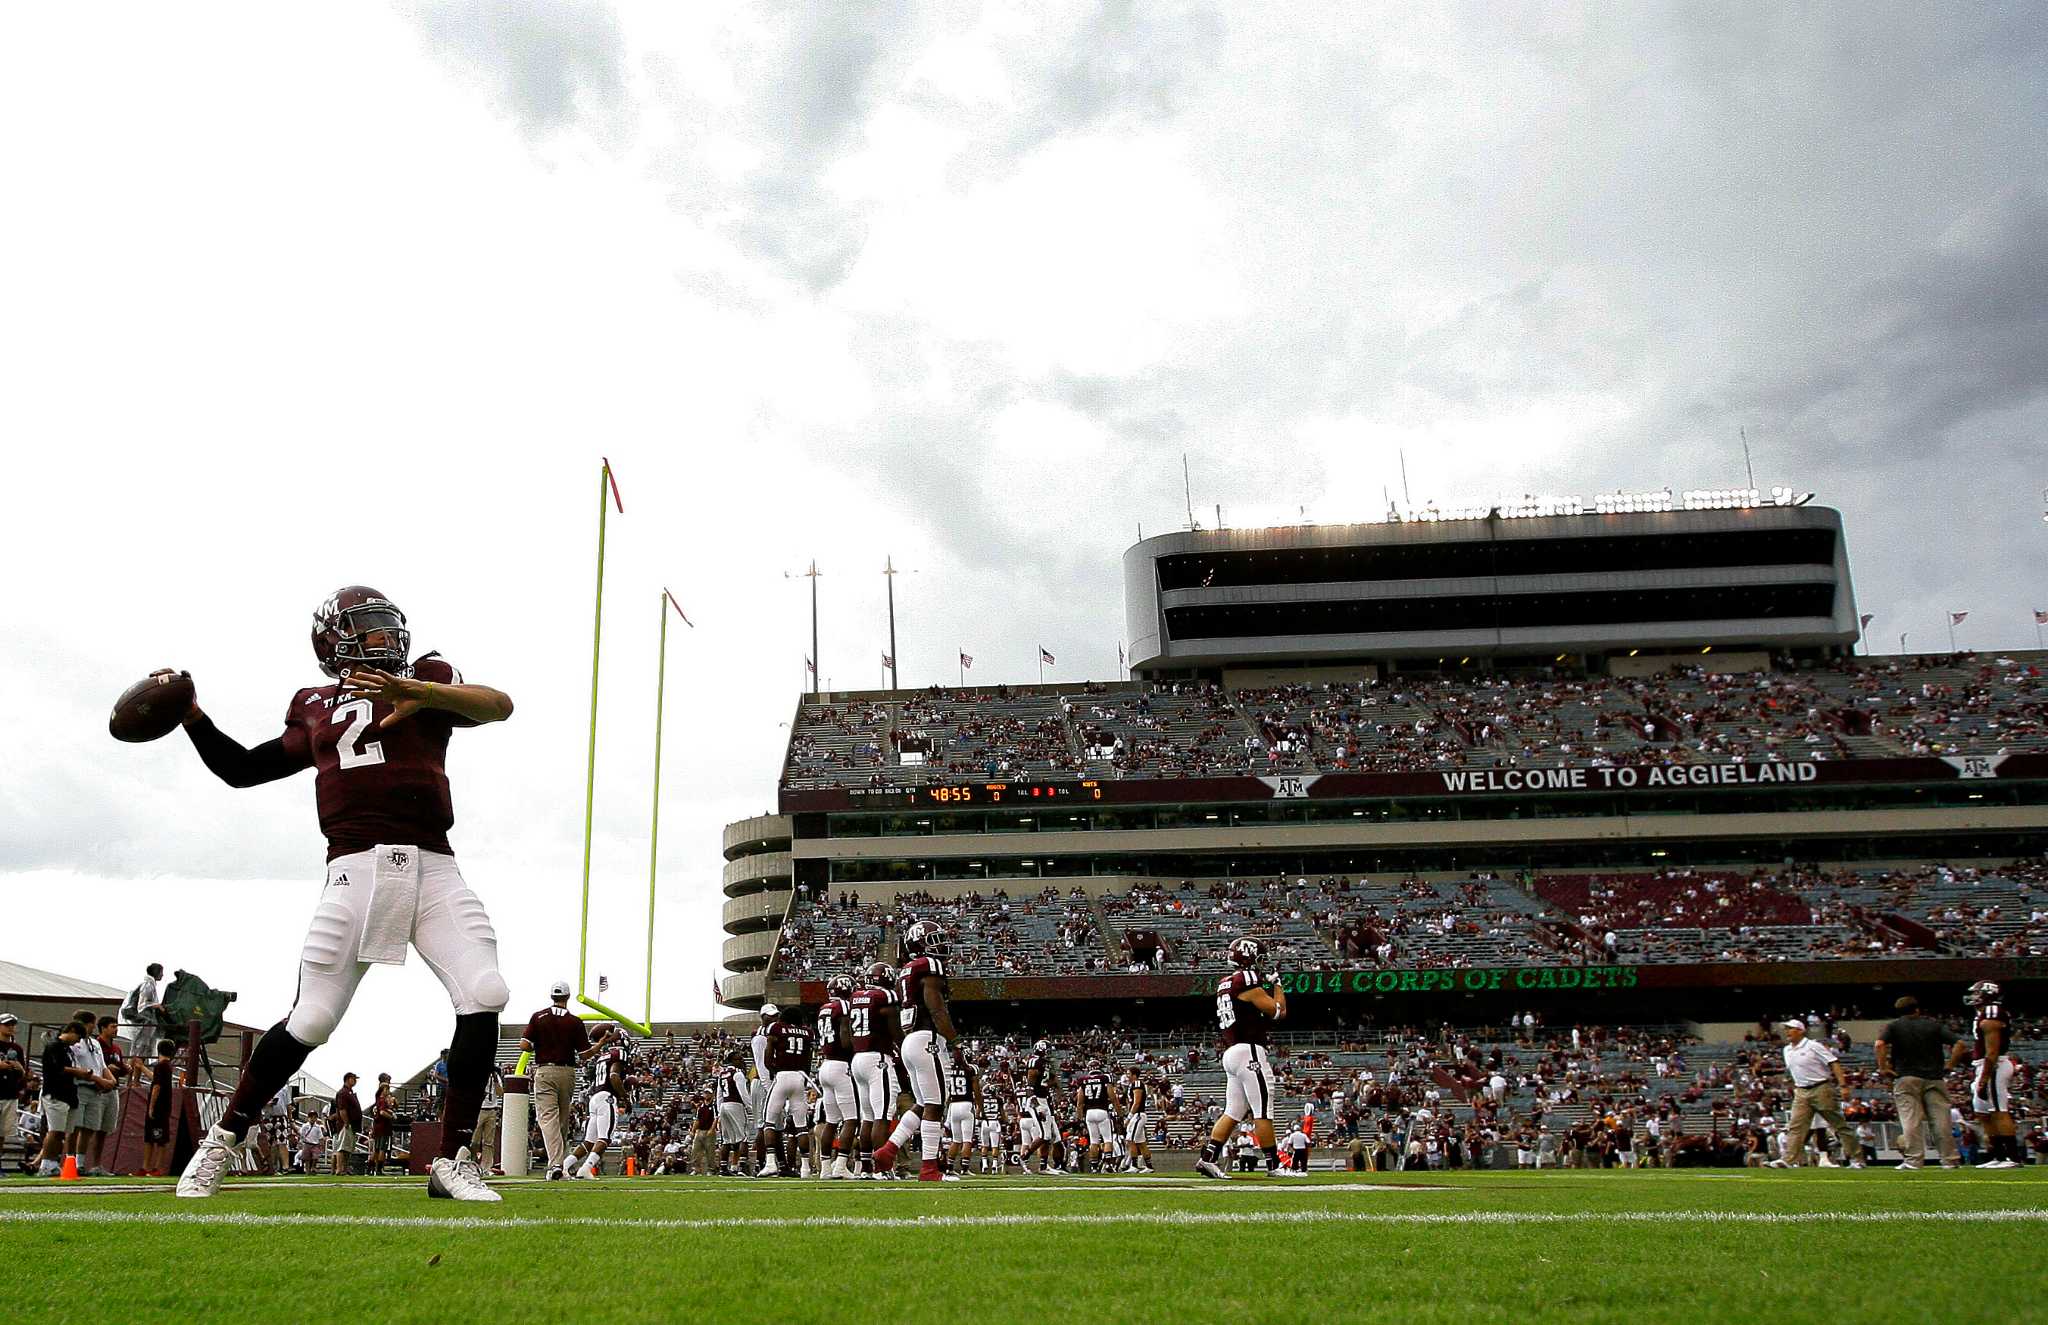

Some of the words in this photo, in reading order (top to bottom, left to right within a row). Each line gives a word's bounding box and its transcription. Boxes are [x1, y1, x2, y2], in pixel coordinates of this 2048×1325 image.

[331, 699, 386, 770] 2
[1442, 768, 1587, 792] WELCOME
[1598, 767, 1638, 788] TO
[1647, 762, 1818, 787] AGGIELAND
[930, 787, 971, 801] 48:55
[993, 791, 1000, 801] 0
[1094, 788, 1101, 799] 0
[1282, 971, 1343, 993] 2014
[1352, 970, 1457, 993] CORPS
[1464, 969, 1507, 990] OF
[1516, 967, 1637, 989] CADETS
[850, 1007, 871, 1037] 21
[786, 1036, 804, 1055] 11
[1084, 1083, 1102, 1100] 47
